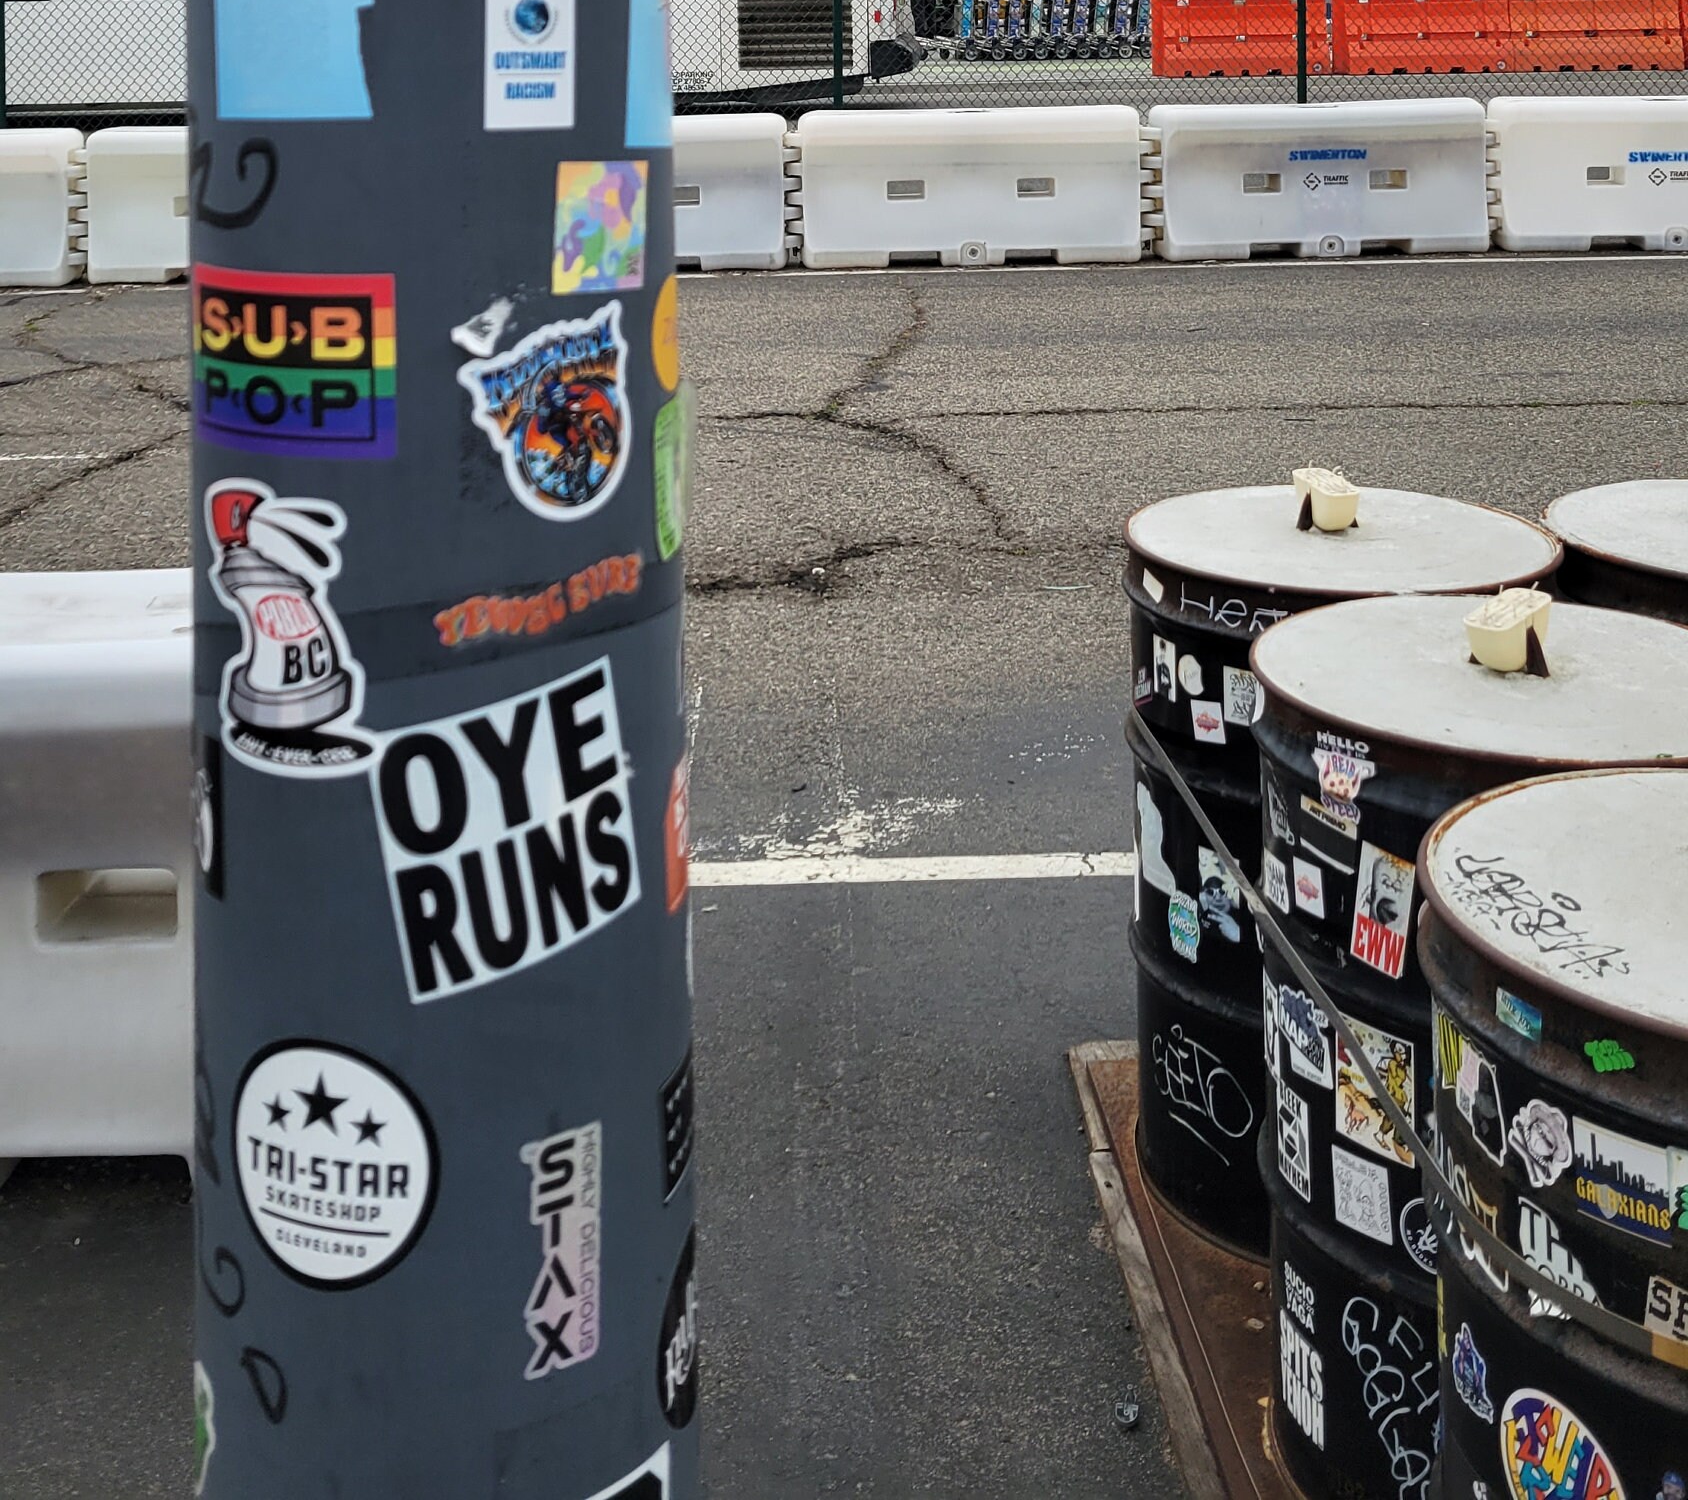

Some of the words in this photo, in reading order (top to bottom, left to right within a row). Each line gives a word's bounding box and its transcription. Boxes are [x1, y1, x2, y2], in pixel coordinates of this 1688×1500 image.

[495, 51, 566, 69] OUTSMART
[505, 82, 555, 99] RACISM
[1288, 148, 1367, 161] SWINERTON
[281, 637, 326, 685] BC
[379, 668, 618, 856] OYE
[1316, 730, 1370, 754] HELLO
[395, 790, 632, 994] RUNS
[1353, 912, 1405, 977] EWW
[1280, 1003, 1308, 1048] NAP
[247, 1135, 410, 1199] TRI-STAR
[580, 1129, 597, 1209] HIGHLY
[265, 1185, 382, 1223] SKATESHOP
[275, 1228, 368, 1258] CLEVELAND
[578, 1221, 597, 1354] DELICIOUS
[1284, 1261, 1315, 1306] SUCIO
[1280, 1309, 1324, 1402] SPITS
